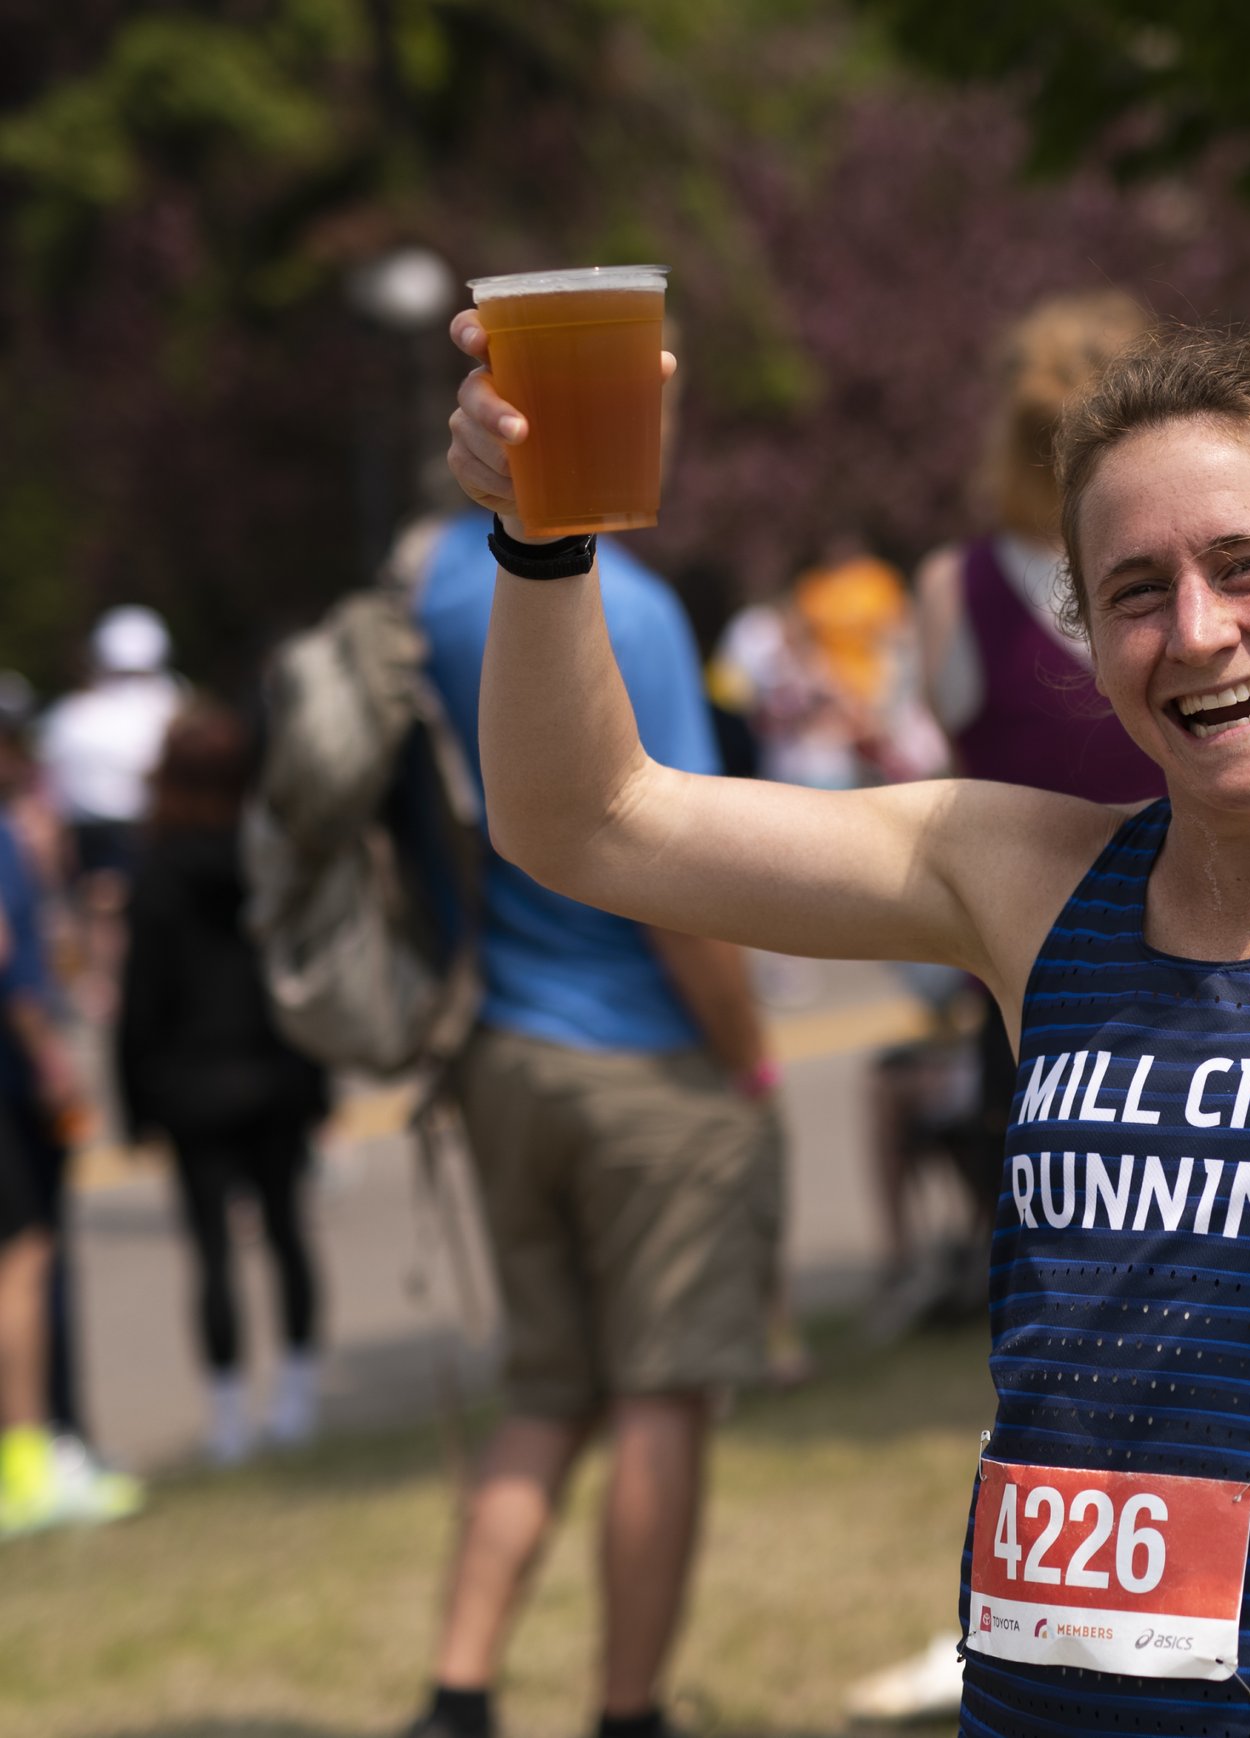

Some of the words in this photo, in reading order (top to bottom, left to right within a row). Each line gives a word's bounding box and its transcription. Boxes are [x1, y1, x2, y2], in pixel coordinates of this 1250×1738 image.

[1017, 1050, 1161, 1126] MILL
[994, 1483, 1169, 1594] 4226
[993, 1616, 1020, 1632] TOYOTA
[1057, 1623, 1114, 1640] MEMBERS
